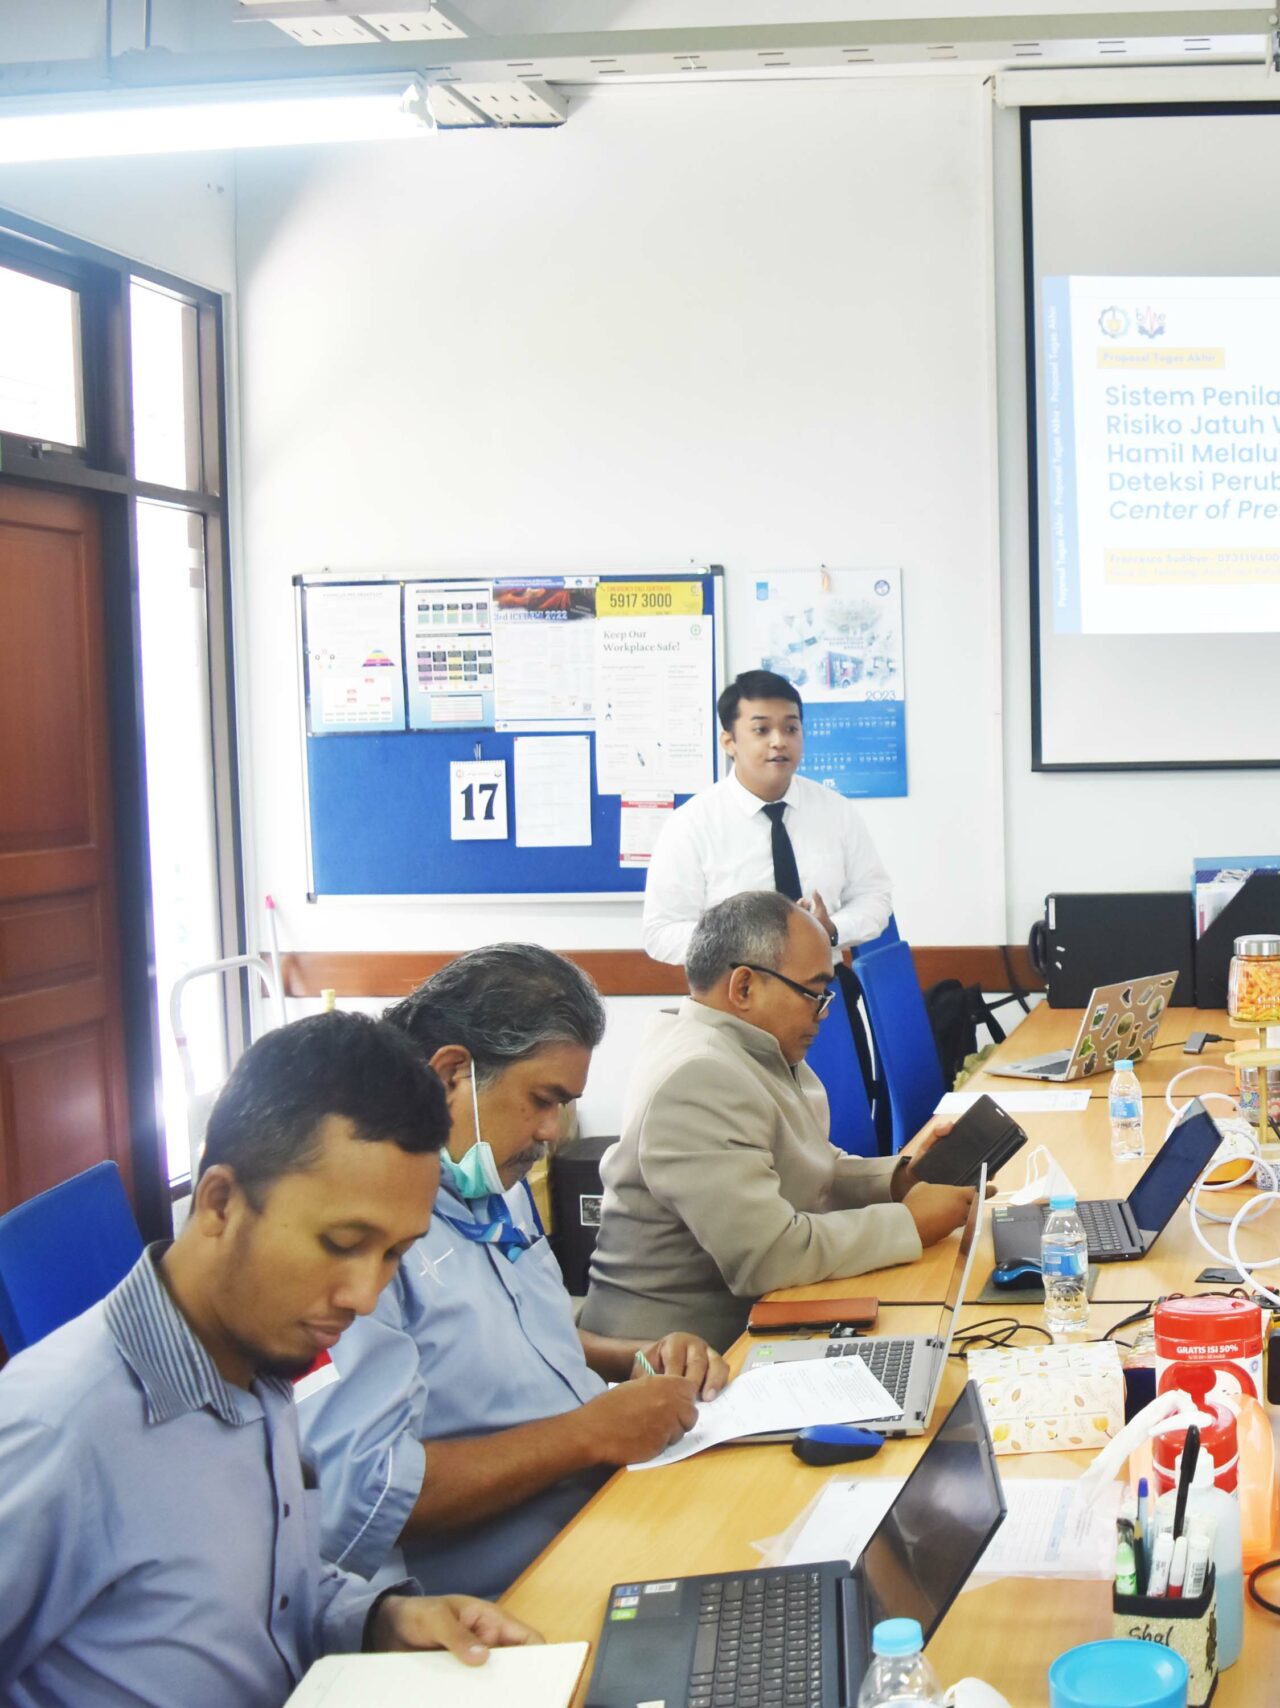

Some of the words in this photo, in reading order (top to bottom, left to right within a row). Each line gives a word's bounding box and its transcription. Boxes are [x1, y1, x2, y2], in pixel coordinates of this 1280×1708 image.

[1105, 384, 1195, 406] Sistem
[1106, 413, 1183, 435] Risiko
[1190, 413, 1265, 435] Jatuh
[1107, 442, 1184, 464] Hamil
[1109, 470, 1204, 492] Deteksi
[1110, 499, 1198, 520] Center
[1205, 498, 1231, 519] of
[609, 593, 638, 608] 5917
[641, 592, 672, 608] 3000
[544, 610, 568, 621] 2022
[604, 631, 627, 640] Keep
[629, 630, 647, 639] Our
[603, 642, 655, 654] Workplace
[657, 641, 680, 651] Safe!
[461, 783, 499, 821] 17
[1176, 1346, 1206, 1355] GRATIS
[1219, 1343, 1239, 1353] 50%
